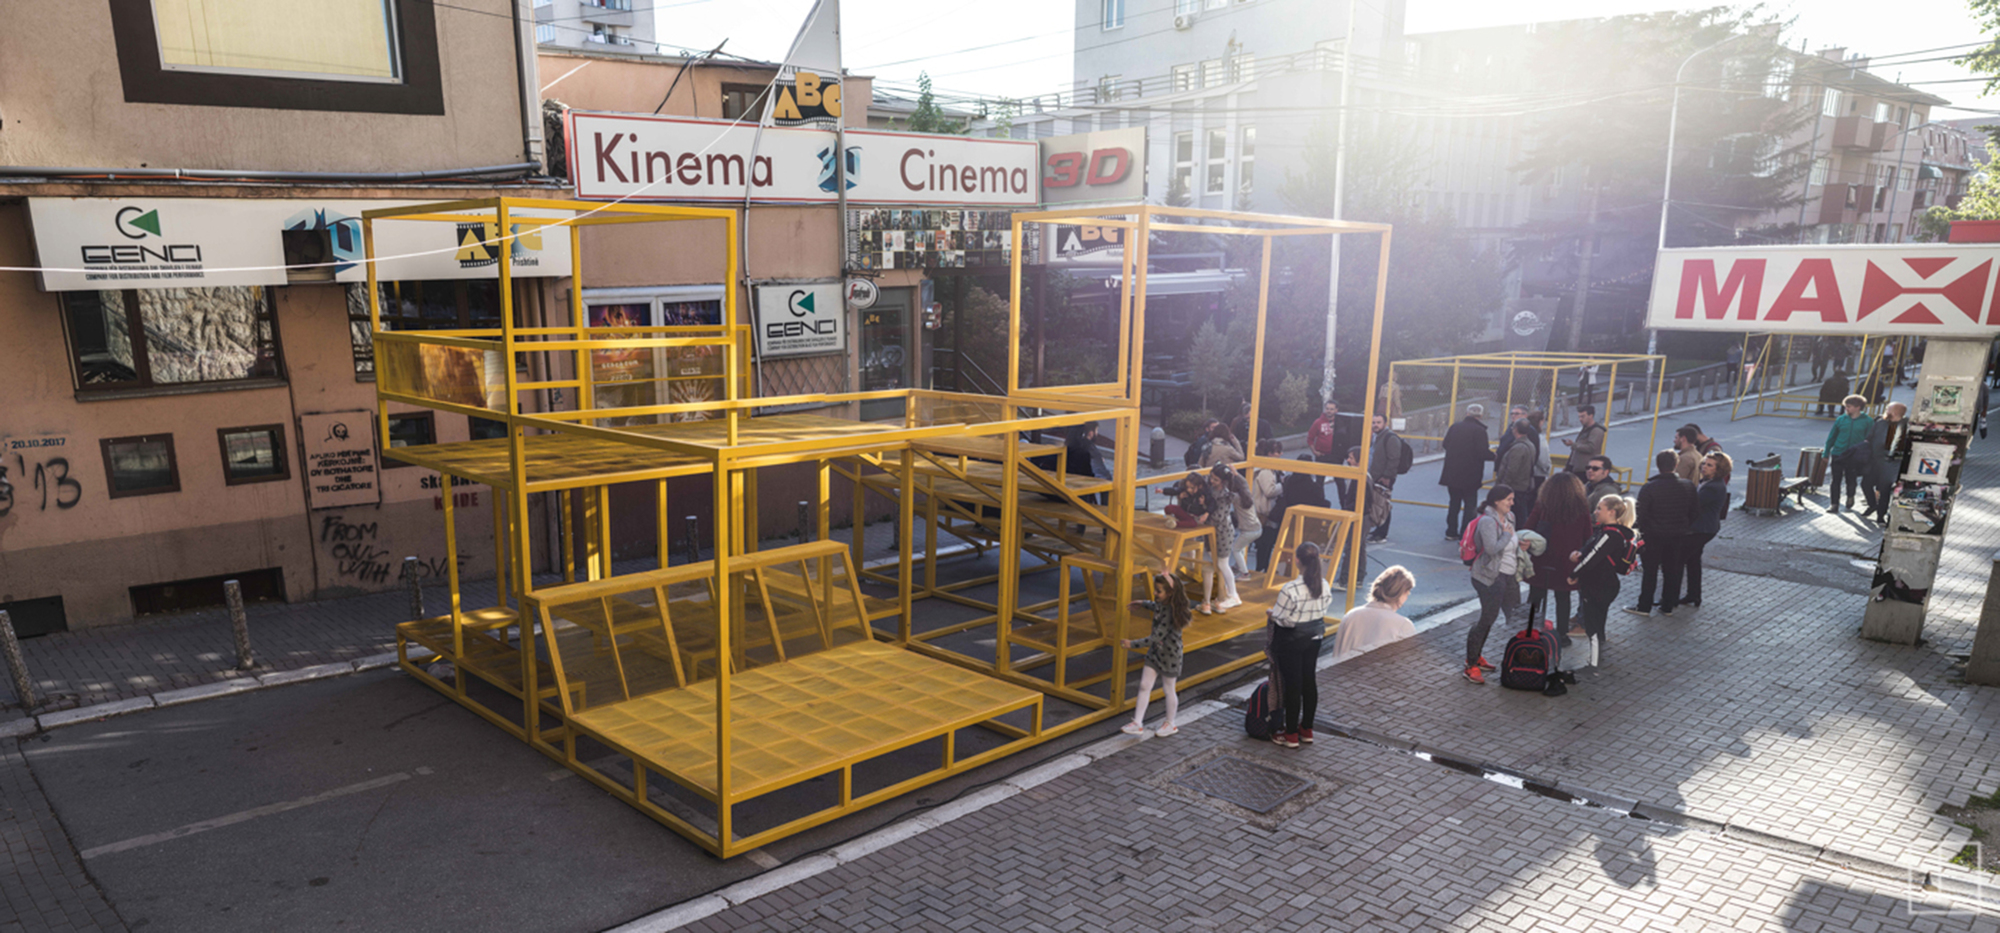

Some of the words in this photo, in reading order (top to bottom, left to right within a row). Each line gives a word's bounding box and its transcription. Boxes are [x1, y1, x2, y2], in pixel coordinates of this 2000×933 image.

[772, 72, 841, 120] ABC
[594, 132, 774, 187] Kinema
[900, 148, 1028, 193] Cinema
[1042, 146, 1131, 188] 3D
[81, 244, 202, 264] GENCI
[766, 318, 837, 339] GENCI
[11, 437, 66, 449] 20.10.2017
[322, 515, 378, 542] FROM
